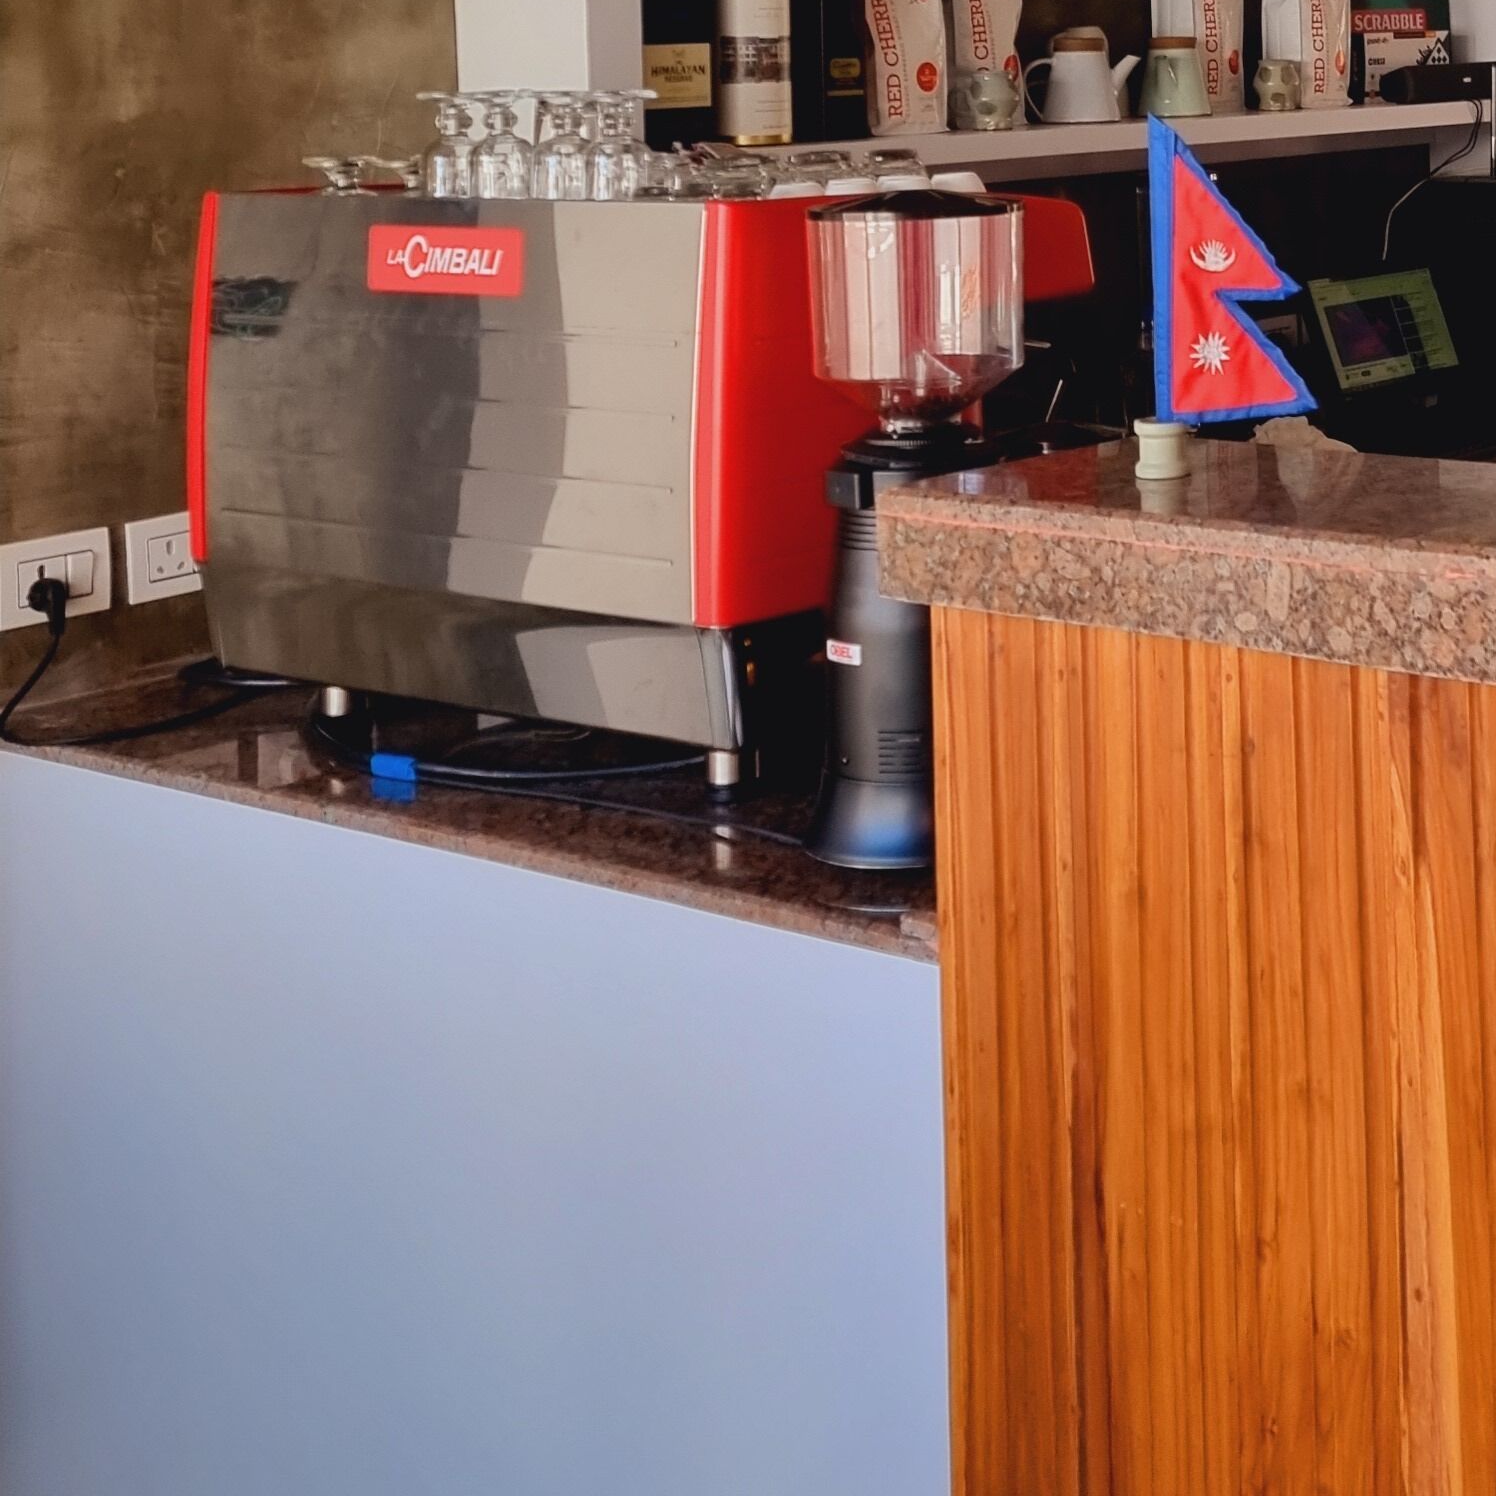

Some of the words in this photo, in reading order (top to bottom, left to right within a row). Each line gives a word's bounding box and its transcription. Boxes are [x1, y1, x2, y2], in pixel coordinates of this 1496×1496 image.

[1354, 13, 1425, 31] SCRABBLE
[651, 64, 706, 76] HIMALAYAN
[1207, 58, 1218, 95] RED
[1314, 57, 1325, 94] RED
[886, 73, 903, 118] RED
